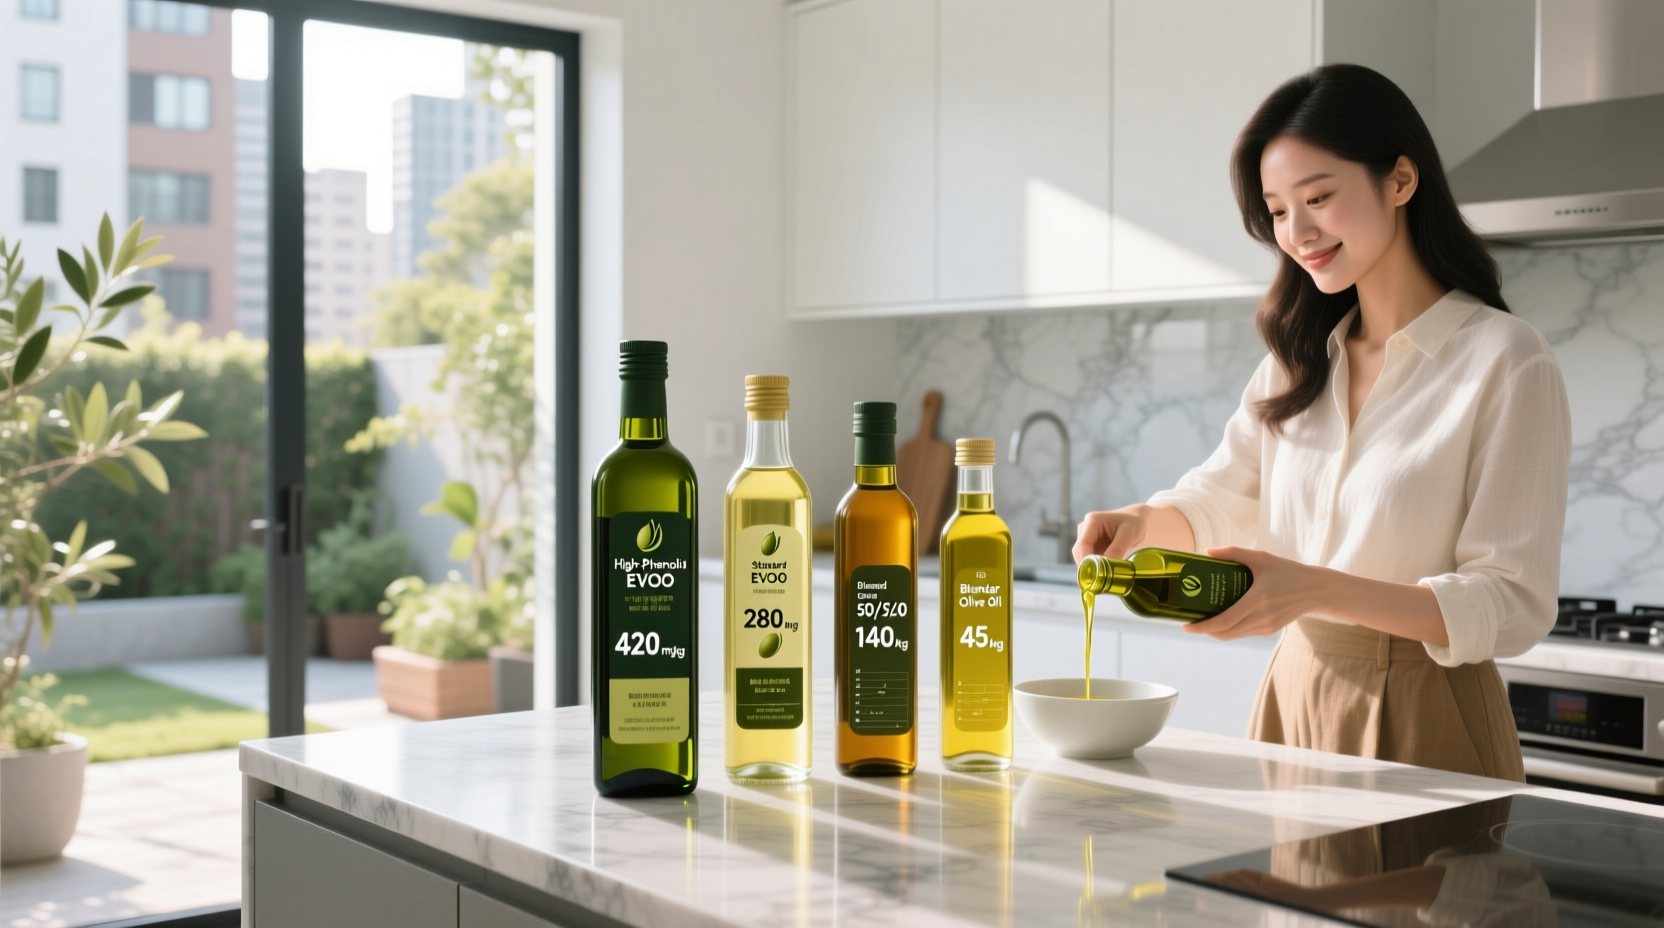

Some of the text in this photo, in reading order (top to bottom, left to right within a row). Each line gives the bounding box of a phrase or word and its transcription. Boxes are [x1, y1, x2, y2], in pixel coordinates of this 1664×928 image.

[626, 573, 675, 588] EVOO
[751, 572, 787, 584] EVOO
[744, 608, 783, 628] 280
[614, 632, 660, 656] 420
[856, 626, 894, 648] 140
[960, 626, 988, 648] 45
